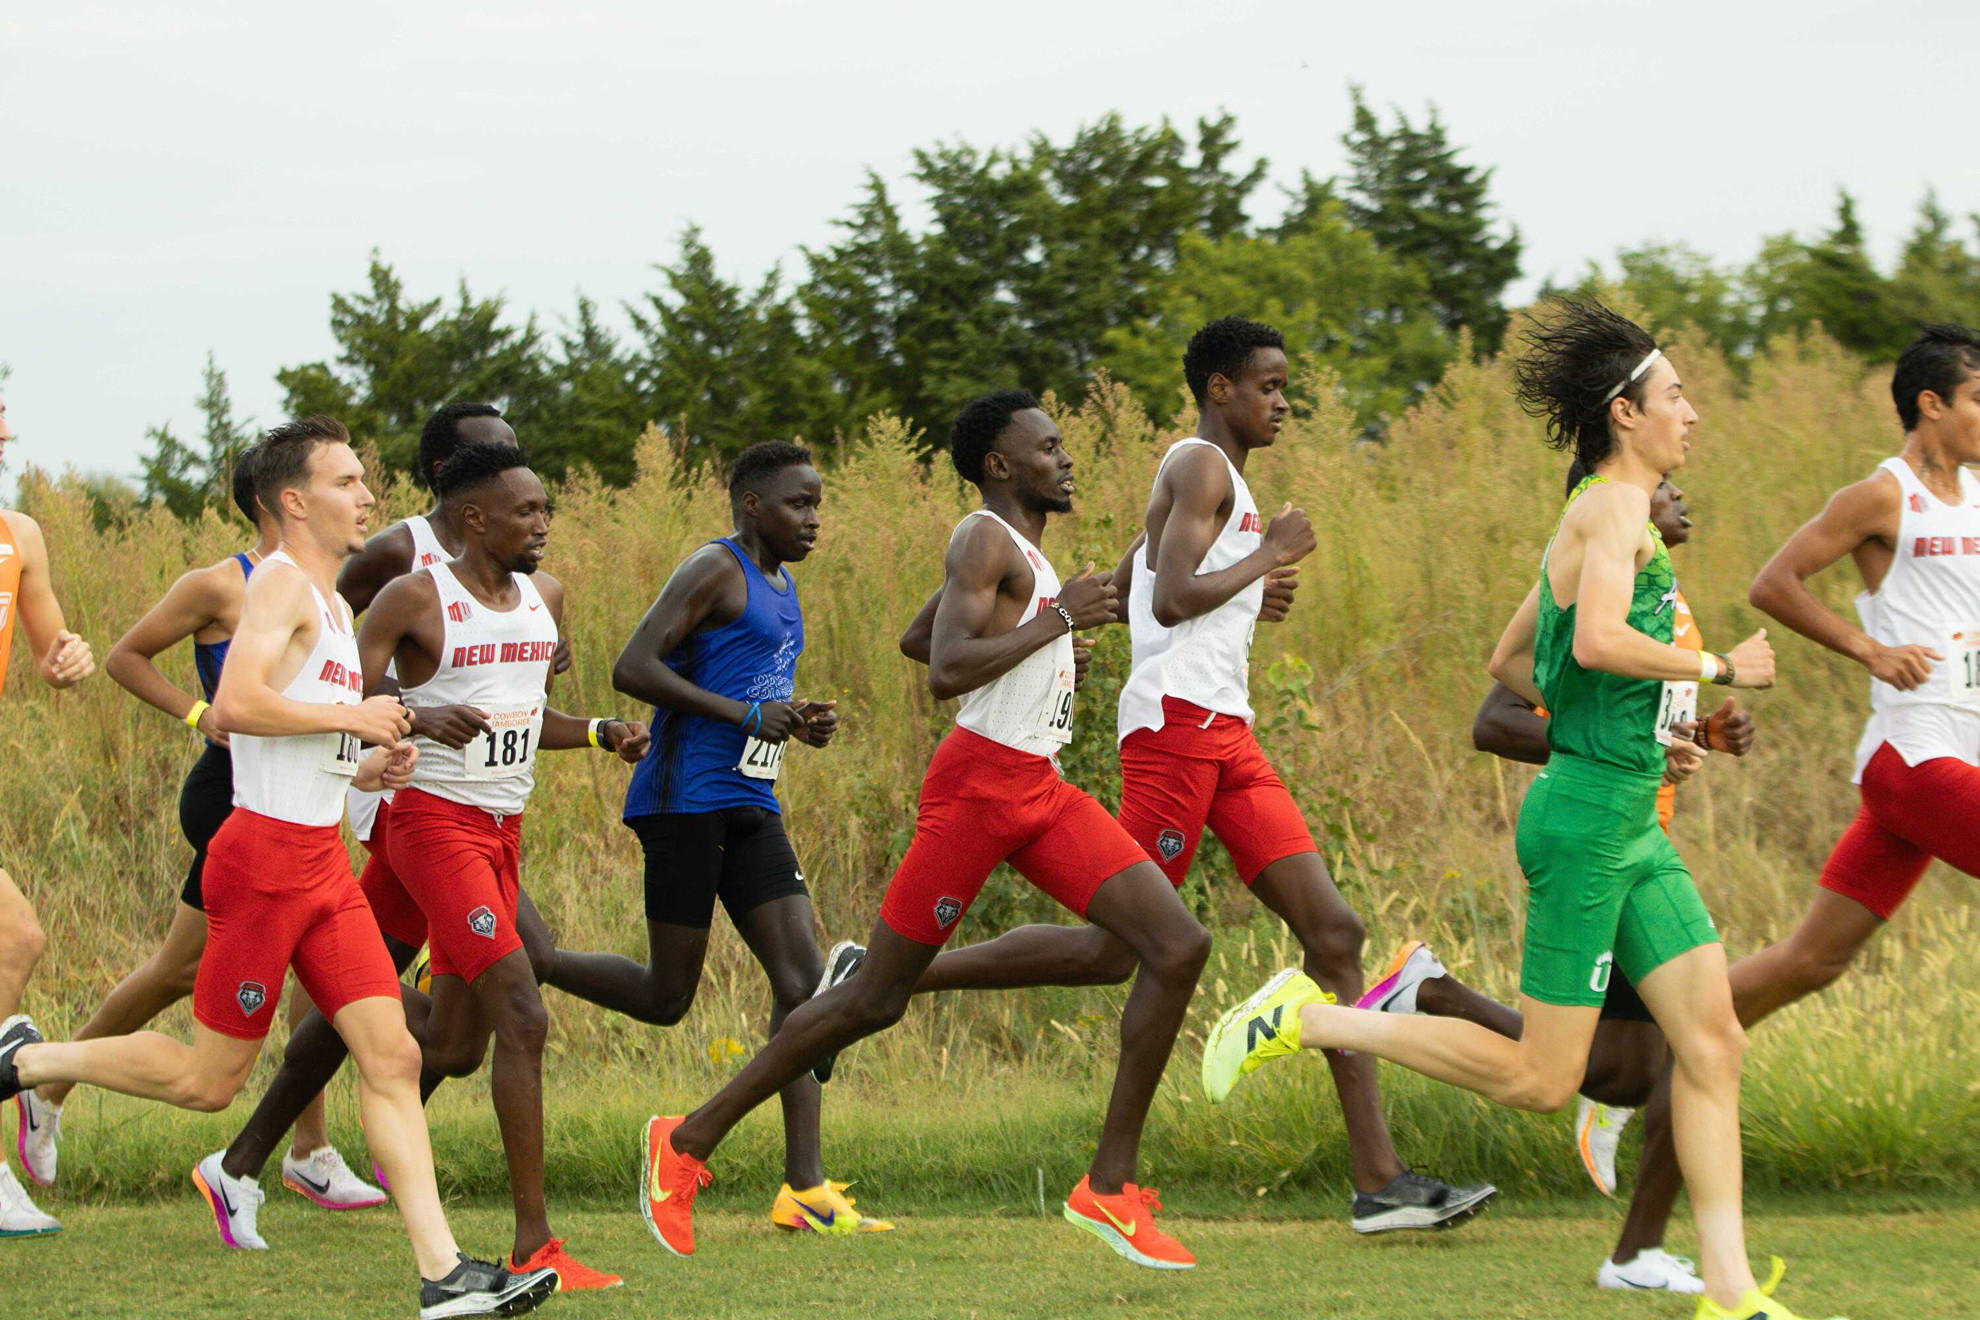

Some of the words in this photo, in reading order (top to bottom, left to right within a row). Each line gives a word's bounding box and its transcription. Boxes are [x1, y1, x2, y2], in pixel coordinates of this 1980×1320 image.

[452, 643, 496, 668] NEW
[500, 641, 556, 663] MEXIC
[492, 718, 531, 728] JAMBOREE
[493, 710, 529, 720] COWBOY
[484, 728, 530, 767] 181
